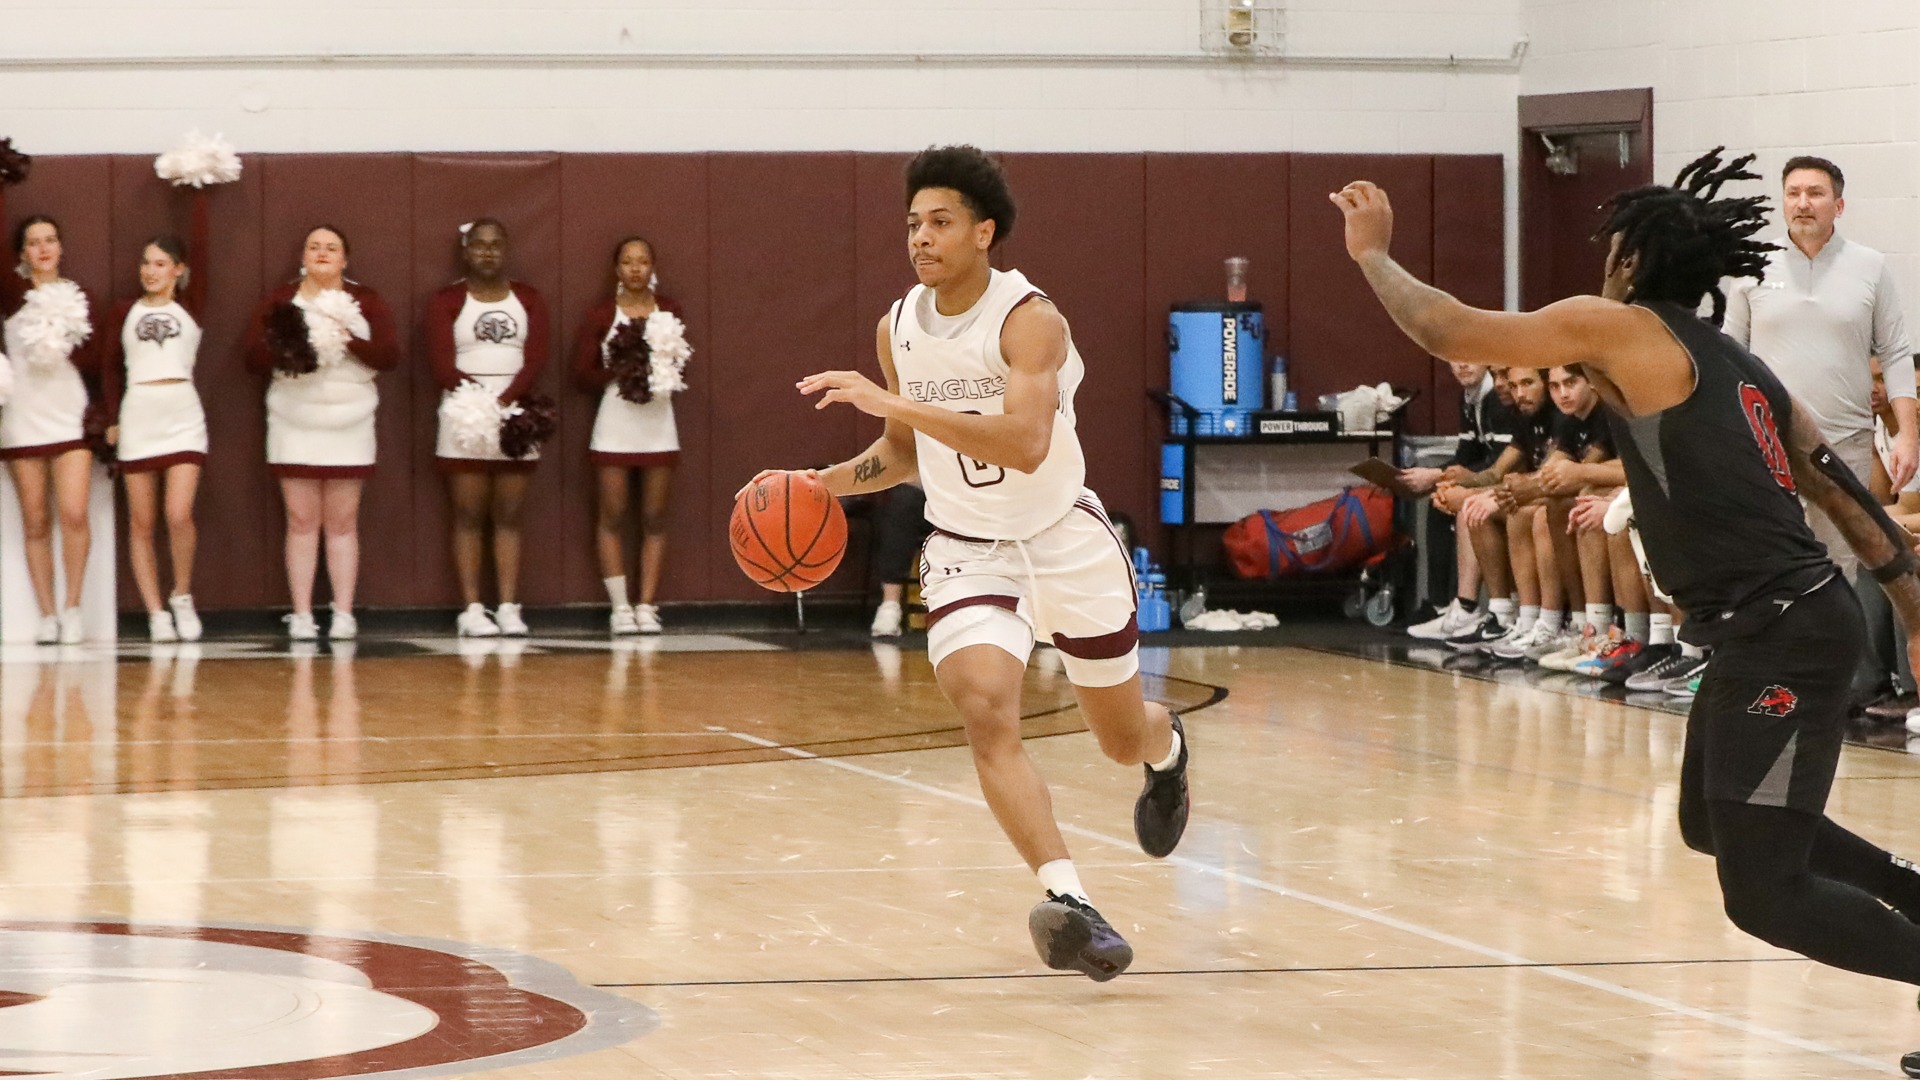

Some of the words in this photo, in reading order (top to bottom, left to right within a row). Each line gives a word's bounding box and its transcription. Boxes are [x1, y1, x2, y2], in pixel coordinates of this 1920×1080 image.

[1224, 318, 1237, 400] POWERADE
[907, 375, 1007, 402] EAGLES
[1262, 421, 1292, 433] POWER
[853, 455, 887, 486] REAL
